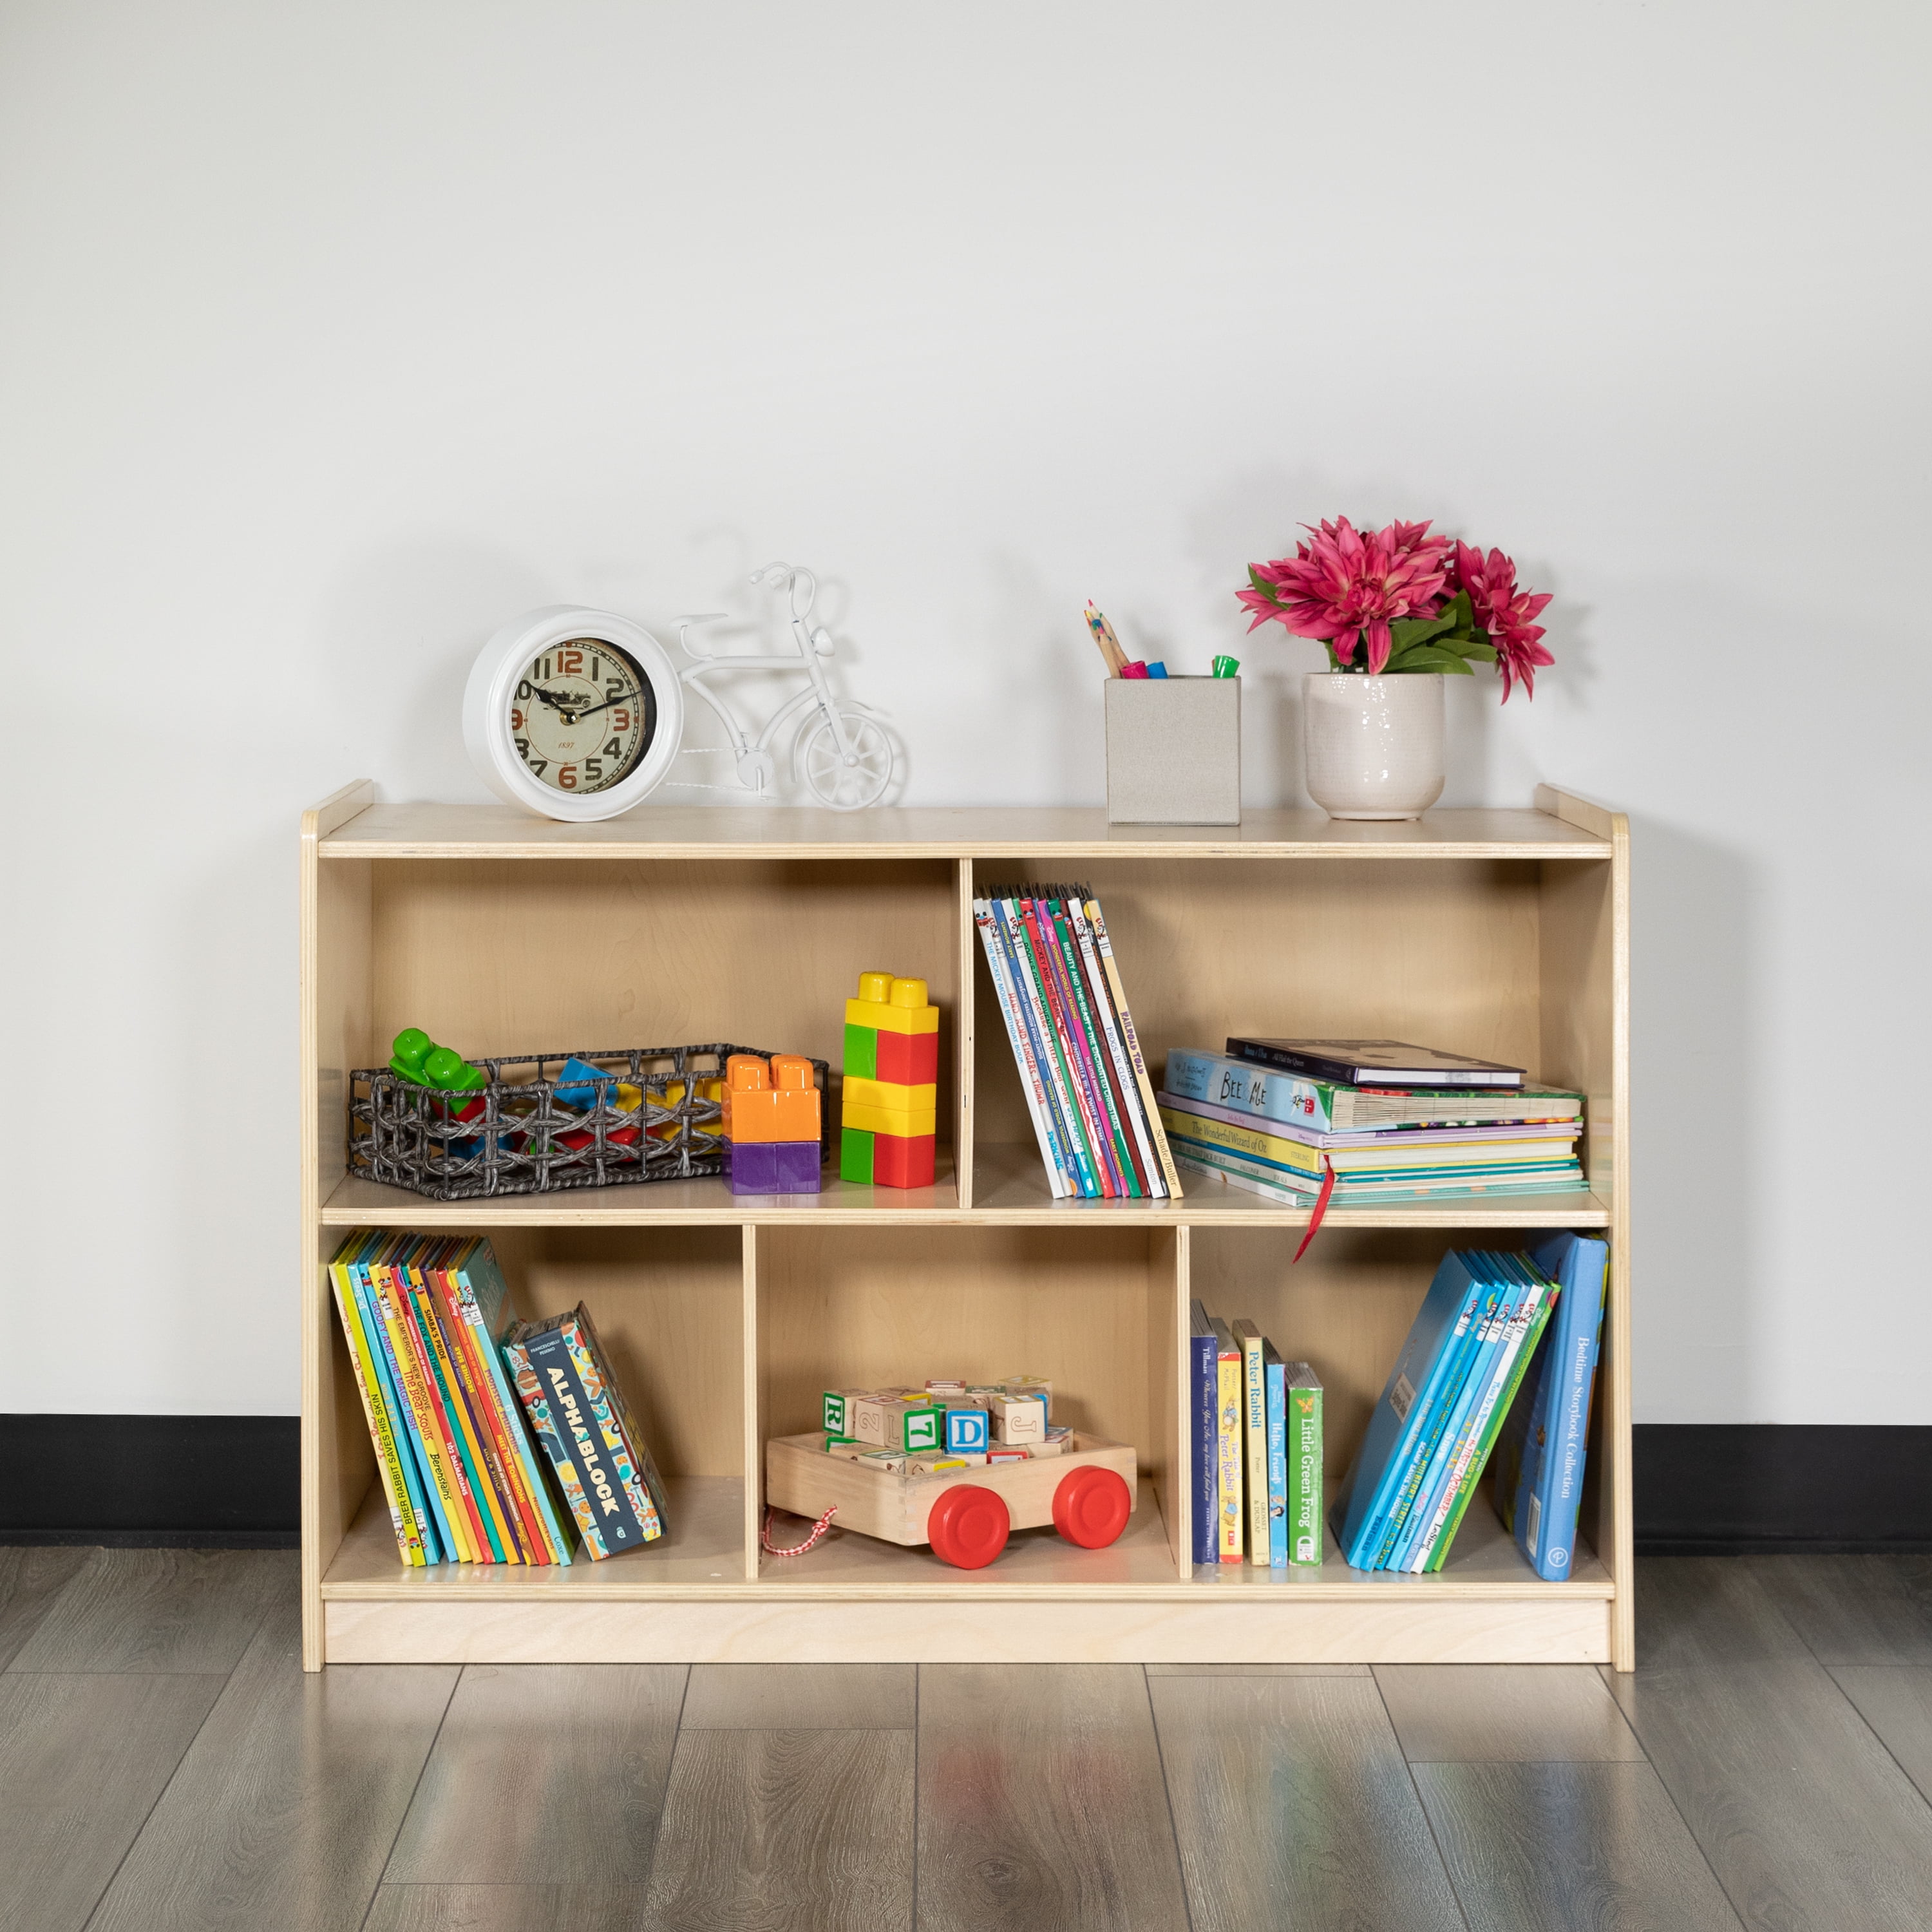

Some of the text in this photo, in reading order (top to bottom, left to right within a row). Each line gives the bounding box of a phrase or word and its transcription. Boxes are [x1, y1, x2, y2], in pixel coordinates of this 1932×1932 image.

[534, 658, 550, 679] 11
[558, 651, 583, 674] 12
[592, 657, 599, 681] 1
[606, 678, 624, 701] 2
[613, 709, 630, 732] 3
[603, 737, 622, 759] 4
[529, 760, 547, 777] 7
[558, 766, 577, 789] 6
[585, 759, 602, 781] 5
[986, 941, 995, 954] THE
[999, 920, 1015, 958] EARLY MOMENTS
[1062, 941, 1075, 967] BEAUTY
[989, 955, 1003, 982] MICKEY
[1050, 943, 1063, 971] WONDERFUL
[1059, 971, 1068, 989] WORLD
[1066, 998, 1078, 1021] READING
[1069, 968, 1081, 986] AND
[997, 983, 1009, 1008] MOUSE
[1074, 986, 1084, 1001] THE
[1004, 1009, 1019, 1043] BIRTHDAY
[1086, 1031, 1097, 1045] THE
[1120, 1010, 1145, 1075] RAILROAD TOAD
[1070, 1041, 1086, 1079] CINDERELLA
[1090, 1046, 1108, 1089] ENCHANTED
[1106, 1027, 1130, 1090] FROGS IN CLOGS
[1045, 1079, 1056, 1102] READING
[1086, 1065, 1095, 1079] LITTLE
[1091, 1079, 1103, 1102] MERMAID
[1220, 1072, 1242, 1101] BEE
[1053, 1110, 1063, 1128] WORLD
[1085, 1096, 1097, 1117] TWIST
[1102, 1089, 1119, 1130] CHRISTMAS
[1091, 1117, 1099, 1126] IN
[1094, 1126, 1104, 1142] TIME
[1046, 1130, 1063, 1170] PERKINS
[1058, 1128, 1070, 1154] WONDERFUL
[1193, 1122, 1202, 1133] The
[1204, 1124, 1231, 1142] Wonderful
[1231, 1132, 1250, 1148] Wizard
[1251, 1139, 1258, 1152] of
[1258, 1140, 1267, 1153] Oz
[1108, 1138, 1124, 1177] EARLY MOMENTS
[1155, 1128, 1178, 1186] Schade/Buller
[350, 1276, 364, 1298] Seuss
[424, 1308, 446, 1360] SIMBA'S PRIDE
[392, 1307, 430, 1411] THE EMPEROR'S NEW GROOVE
[406, 1316, 419, 1343] WONDERFUL
[414, 1343, 423, 1358] WORLD
[421, 1365, 431, 1385] READING
[412, 1304, 450, 1403] THE FOX AND THE HOUND
[371, 1300, 387, 1332] GOOFY
[381, 1334, 394, 1355] AND
[388, 1356, 400, 1374] THE
[395, 1377, 410, 1407] MAGIC
[405, 1410, 417, 1430] FISH
[402, 1370, 417, 1388] The
[455, 1345, 475, 1393] BROTHER BEAR
[408, 1387, 425, 1413] Bear
[484, 1368, 504, 1409] Monster
[1249, 1352, 1261, 1428] Peter Rabbit
[504, 1403, 526, 1445] 6 Sticks
[828, 1400, 841, 1425] R
[1560, 1336, 1590, 1499] Bedtime Storybook Collection
[547, 1368, 620, 1517] ALPHABLOCK
[911, 1421, 933, 1437] 7
[955, 1419, 981, 1444] D
[1271, 1423, 1282, 1449] Hello,
[371, 1393, 413, 1524] BRER RABBIT SAVES HIS SKIN
[1435, 1431, 1455, 1461] Snow
[445, 1441, 468, 1495] 102 DALMATIANS
[492, 1452, 503, 1472] READING
[496, 1434, 526, 1503] MEET THE ROBINSONS
[1220, 1434, 1235, 1491] Peter Rabbit
[1298, 1418, 1314, 1528] Little Green Frog
[1464, 1456, 1479, 1479] BUG'S
[430, 1452, 451, 1501] Berenstains
[501, 1479, 510, 1495] WORLD
[1386, 1441, 1428, 1519] SCAMP SAVES THE HOUSE
[1458, 1479, 1470, 1495] LIFE
[506, 1495, 519, 1522] WONDERFUL
[1360, 1515, 1383, 1552] Eastman
[1401, 1513, 1419, 1544] Eastman
[553, 1535, 565, 1555] Coxe
